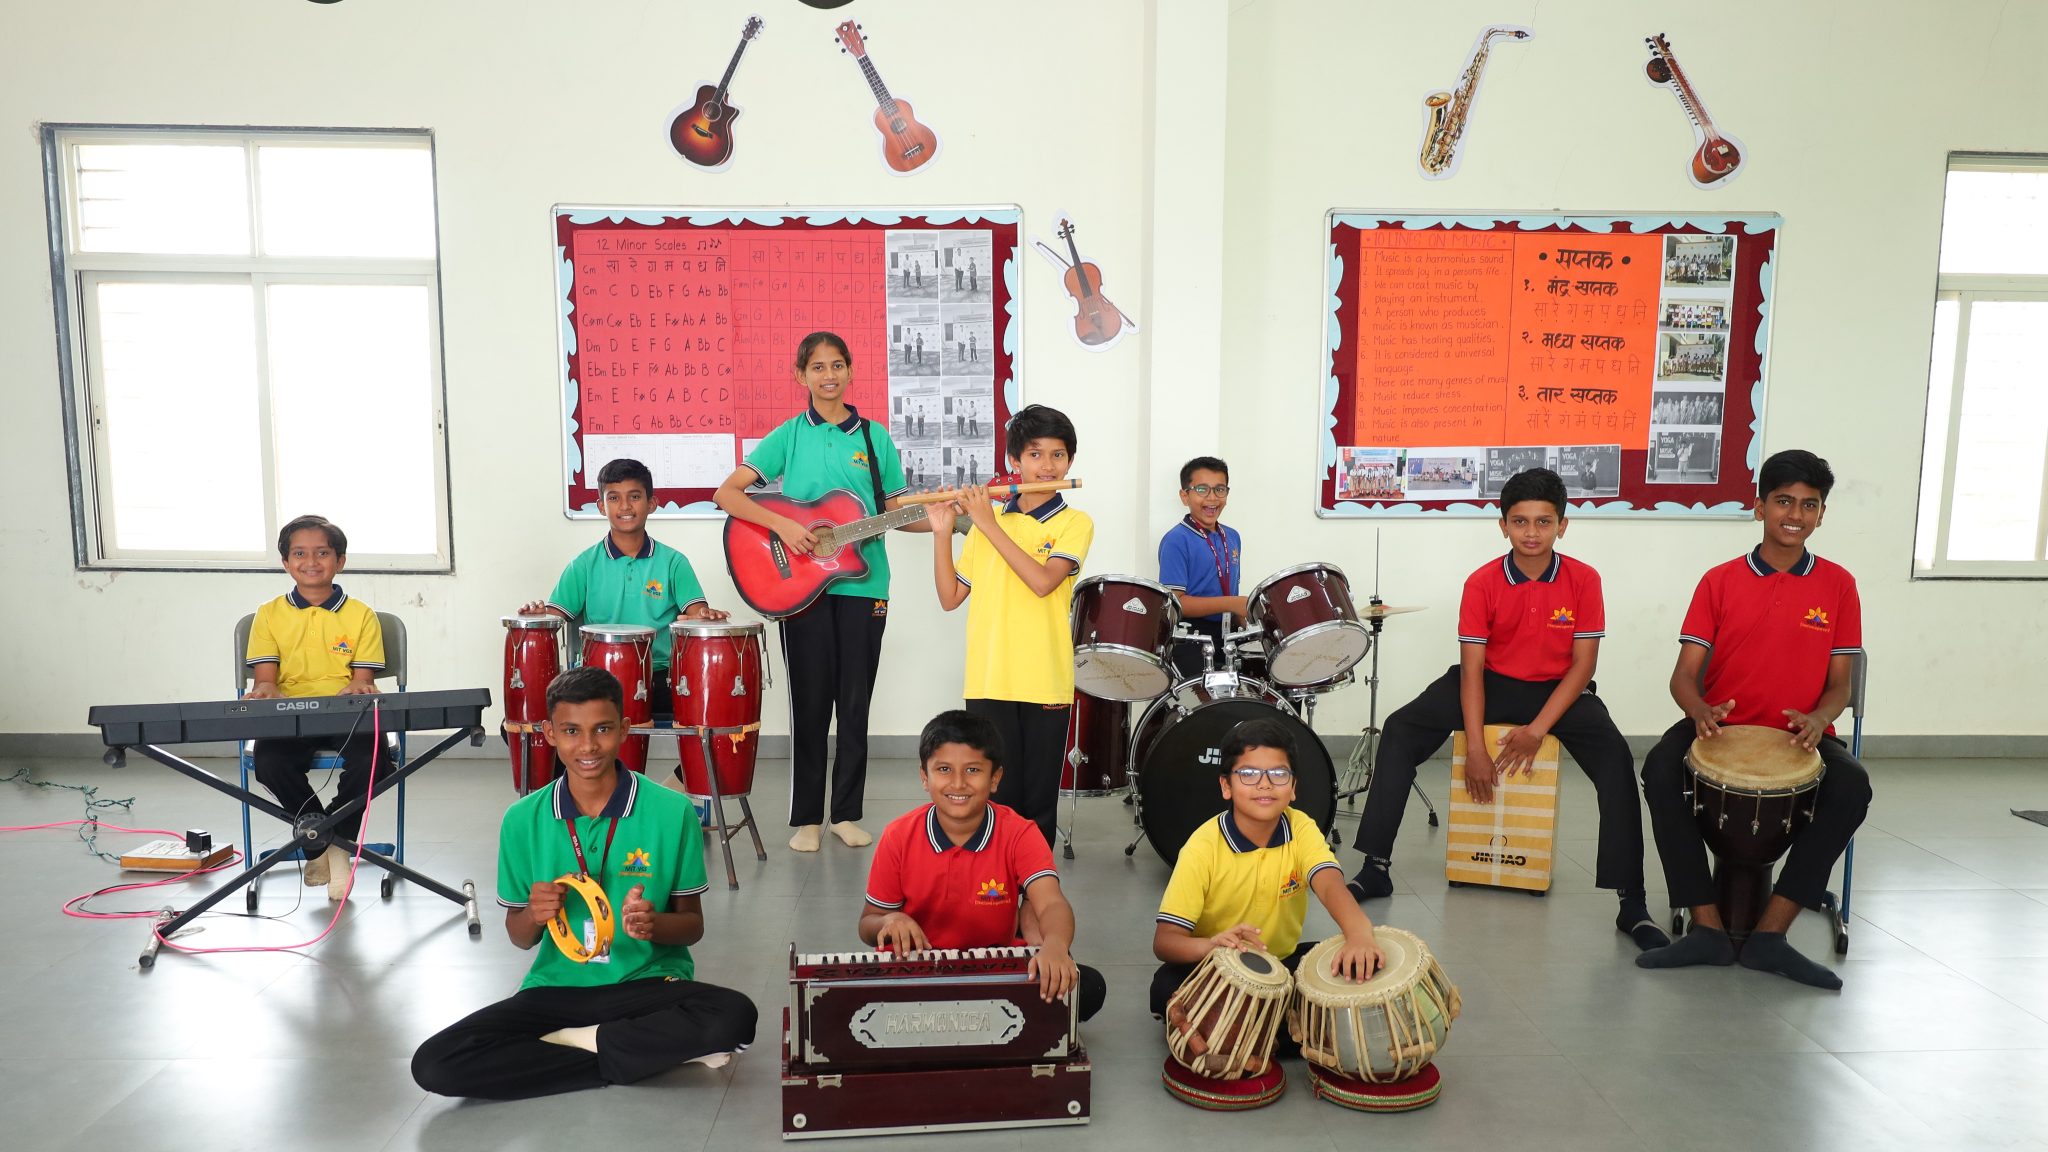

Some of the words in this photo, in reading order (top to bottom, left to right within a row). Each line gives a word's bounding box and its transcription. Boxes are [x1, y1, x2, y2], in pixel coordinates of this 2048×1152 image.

[597, 239, 609, 250] 12
[616, 239, 647, 250] Minor
[655, 239, 687, 250] Scales
[1452, 234, 1496, 247] MUSIC
[1375, 251, 1400, 262] Music
[1404, 252, 1410, 262] is
[583, 265, 596, 274] Cm
[1376, 265, 1382, 275] It
[1385, 267, 1413, 276] spreads
[1418, 267, 1430, 277] joy
[1453, 268, 1482, 277] persons
[583, 285, 598, 295] Cm
[609, 284, 617, 296] C
[631, 284, 639, 297] D
[649, 285, 662, 298] Eb
[668, 284, 676, 298] F
[682, 284, 690, 297] G
[698, 285, 711, 297] Ab
[718, 284, 728, 297] Bb
[1436, 280, 1462, 289] music
[1468, 281, 1479, 294] by
[1375, 292, 1405, 305] playing
[1376, 307, 1382, 316] A
[1386, 309, 1414, 320] person
[1420, 306, 1439, 316] who
[1443, 307, 1486, 320] produces
[630, 313, 642, 328] Eb
[650, 313, 656, 328] E
[682, 314, 695, 325] Ab
[700, 313, 706, 325] A
[716, 313, 728, 325] Bb
[1373, 320, 1396, 330] music
[1400, 320, 1407, 330] is
[1411, 320, 1438, 330] known
[586, 339, 600, 352] Dm
[610, 338, 618, 352] D
[632, 338, 639, 351] E
[650, 338, 656, 352] F
[664, 338, 671, 351] G
[685, 339, 691, 351] A
[698, 338, 710, 351] Bb
[717, 338, 725, 351] C
[1374, 336, 1396, 345] Music
[1402, 335, 1417, 344] has
[1422, 334, 1453, 346] healing
[1374, 350, 1381, 359] It
[1384, 350, 1391, 359] is
[1395, 350, 1439, 360] considered
[1455, 348, 1495, 358] universal
[588, 362, 606, 376] Ebm
[612, 362, 626, 376] Eb
[633, 362, 640, 376] F
[665, 364, 679, 376] Ab
[684, 363, 696, 376] Bb
[701, 363, 709, 376] B
[1374, 378, 1395, 387] There
[1418, 377, 1443, 387] many
[1446, 376, 1472, 388] genres
[1475, 375, 1485, 384] of
[588, 388, 602, 402] Em
[612, 388, 620, 403] E
[650, 388, 657, 402] G
[667, 388, 675, 402] A
[684, 388, 691, 402] B
[701, 388, 709, 402] C
[720, 388, 729, 401] D
[1374, 392, 1397, 400] Music
[1403, 391, 1430, 400] reduce
[1373, 406, 1396, 416] Music
[1403, 405, 1439, 416] improves
[589, 417, 603, 432] Fm
[614, 415, 620, 431] F
[633, 415, 640, 430] G
[651, 416, 664, 429] Ab
[670, 415, 682, 428] Bb
[686, 415, 694, 428] C
[719, 415, 732, 426] Eb
[1373, 420, 1397, 429] Music
[1400, 419, 1408, 428] is
[1411, 419, 1429, 428] also
[1434, 419, 1466, 429] present
[1473, 417, 1482, 427] in
[276, 701, 319, 710] CASIO
